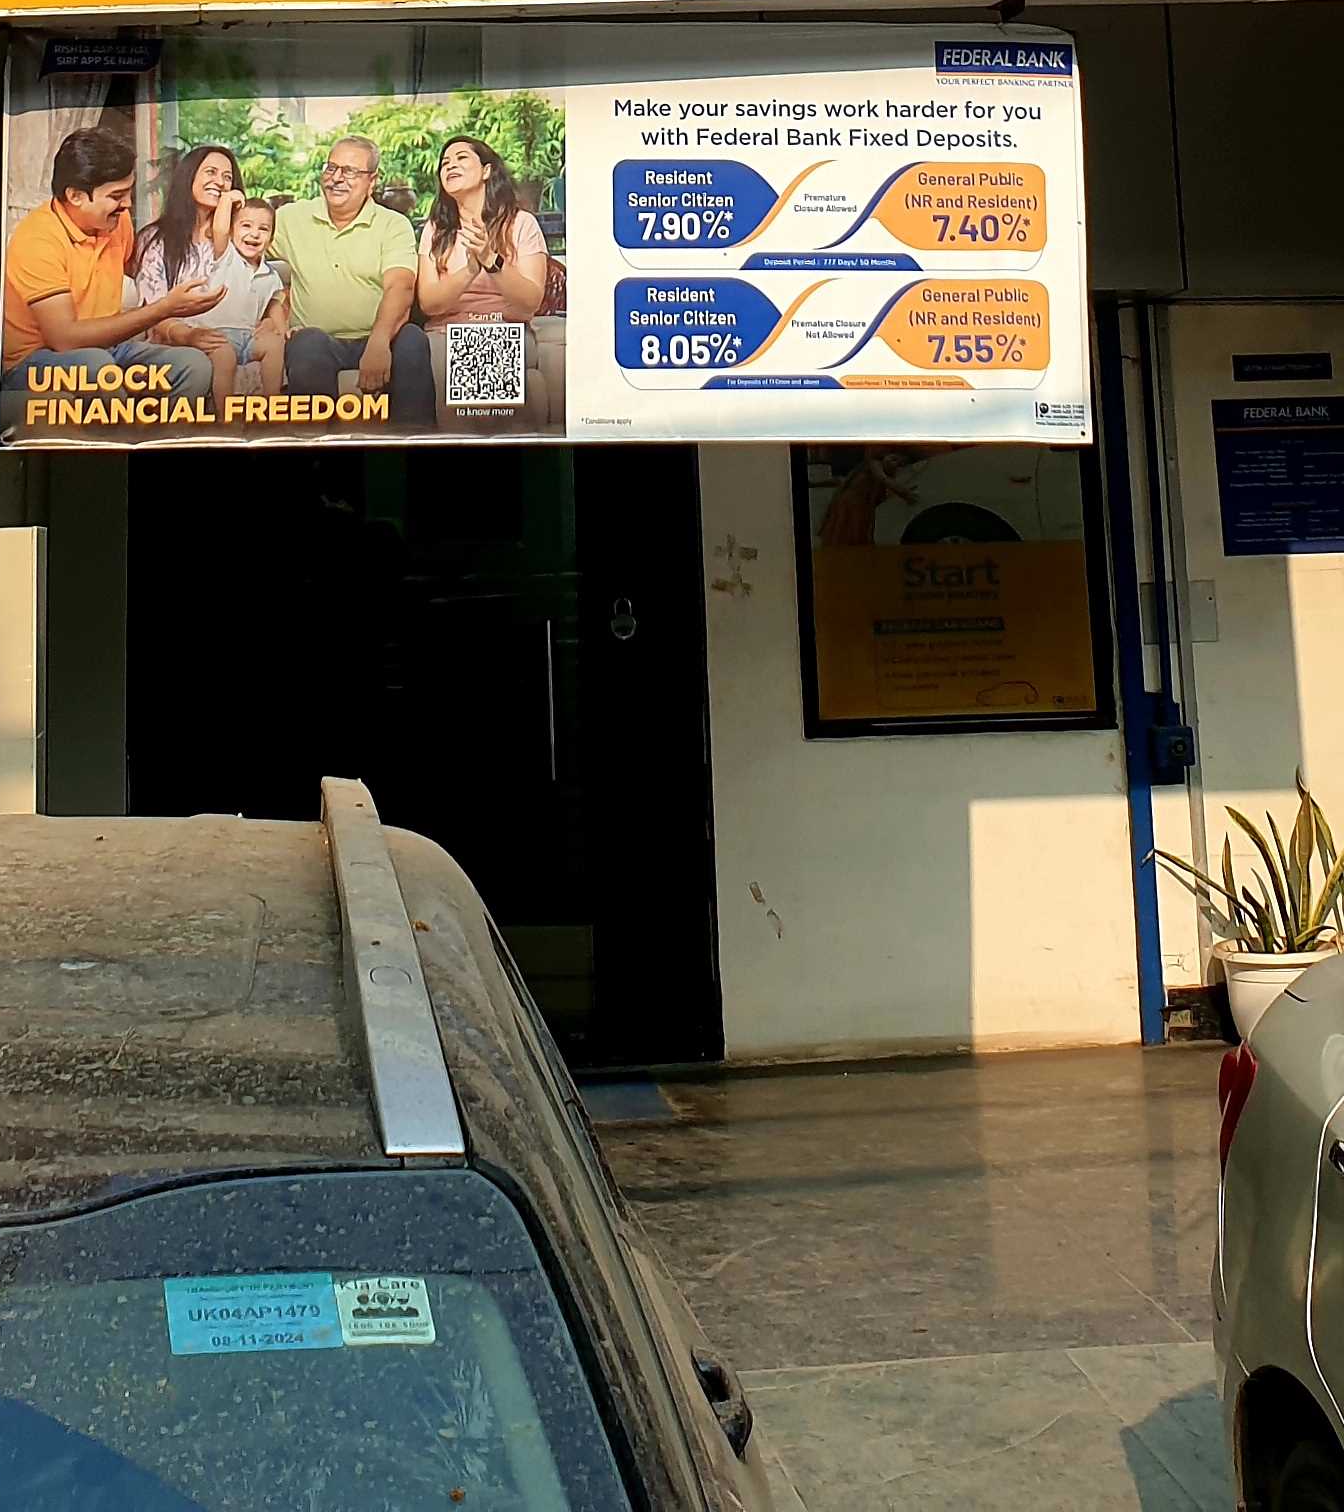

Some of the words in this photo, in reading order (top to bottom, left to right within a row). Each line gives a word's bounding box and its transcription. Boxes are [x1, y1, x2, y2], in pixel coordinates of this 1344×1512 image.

[942, 48, 1013, 67] FEDERAL
[1016, 49, 1066, 69] BANK
[936, 77, 960, 86] YOUR
[997, 78, 1036, 87] BANKING
[614, 99, 671, 119] Make
[679, 103, 728, 122] your
[735, 99, 818, 122] savings
[824, 99, 879, 119] work
[885, 99, 958, 120] harder
[964, 100, 996, 120] for
[1002, 105, 1042, 124] you
[641, 126, 689, 147] with
[696, 127, 779, 147] Federal
[787, 127, 842, 147] Bank
[849, 128, 909, 148] Fixed
[916, 128, 1018, 151] Deposits.
[645, 170, 713, 186] Resident
[918, 172, 976, 187] General
[979, 172, 1024, 187] Public
[628, 192, 678, 208] Senior
[681, 192, 734, 208] Citizen
[803, 193, 847, 202] Premature
[904, 193, 933, 211] (NR
[936, 195, 963, 209] and
[967, 194, 1038, 211] Resident)
[793, 204, 825, 213] Closure
[825, 204, 858, 213] Allowed
[647, 287, 715, 303] Resident
[922, 288, 980, 303] General
[984, 288, 1029, 303] Public
[629, 310, 680, 326] Senior
[683, 310, 736, 326] Citizen
[791, 320, 834, 329] Premature
[835, 320, 867, 328] Closure
[908, 310, 937, 327] (NR
[940, 311, 968, 326] and
[972, 310, 1042, 328] Resident)
[805, 330, 820, 339] Not
[822, 330, 855, 339] Allowed
[26, 363, 172, 393] UNLOCK
[25, 397, 216, 425] FINANCIAL
[223, 393, 390, 424] FREEDOM
[467, 407, 491, 416] know
[491, 408, 515, 416] more
[1243, 406, 1292, 419] FEDERAL
[1295, 405, 1330, 418] BANK
[902, 554, 1000, 587] Start
